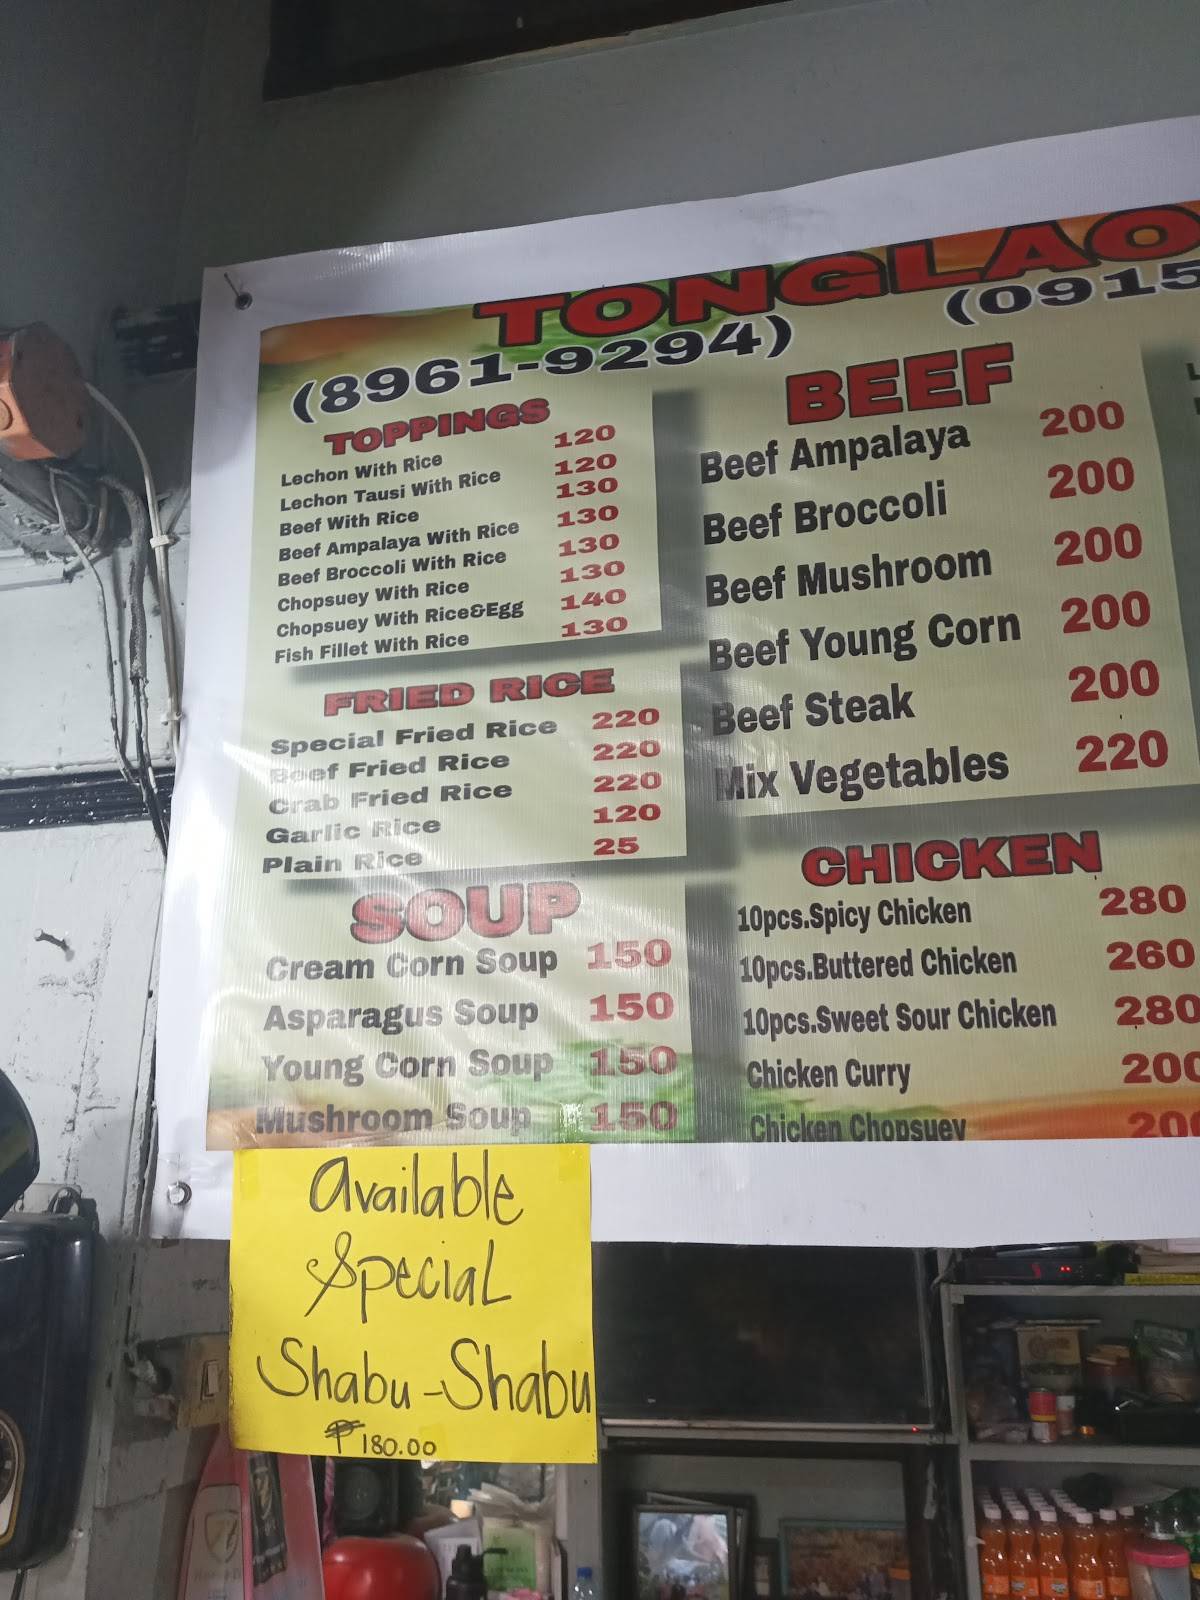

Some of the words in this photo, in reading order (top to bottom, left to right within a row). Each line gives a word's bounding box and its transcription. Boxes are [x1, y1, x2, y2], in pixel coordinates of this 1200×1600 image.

[474, 204, 1200, 346] TONGLAO
[946, 259, 1200, 327] (0915
[292, 314, 793, 422] (8961-9294)
[786, 342, 1014, 426] BEEF
[324, 398, 550, 456] TOPPINGS
[700, 441, 778, 484] Beef
[790, 424, 970, 471] Ampalaya
[1040, 400, 1125, 437] 200
[280, 492, 348, 511] Lechon
[354, 485, 405, 504] Tausi
[411, 477, 452, 497] With
[459, 470, 501, 488] Rice
[555, 454, 617, 476] 120
[281, 468, 349, 487] Lechon
[355, 461, 397, 480] With
[403, 454, 443, 473] Rice
[554, 425, 615, 448] 120
[280, 518, 322, 537] Beef
[328, 513, 370, 531] With
[377, 509, 419, 525] Rice
[556, 477, 618, 499] 130
[703, 503, 782, 545] Beef
[795, 479, 947, 534] Broccoli
[1047, 457, 1135, 499] 200
[279, 543, 321, 562] Beef
[327, 534, 421, 558] Ampalaya
[427, 528, 470, 547] With
[477, 520, 519, 540] Rice
[557, 505, 619, 528] 130
[277, 590, 369, 613] Chopsuey
[375, 586, 419, 604] With
[426, 580, 469, 598] Rice
[560, 560, 625, 583] 130
[278, 568, 320, 587] Beef
[327, 561, 406, 581] Broccoli
[412, 556, 456, 574] With
[463, 550, 507, 568] Rice
[558, 534, 620, 557] 130
[706, 566, 785, 607] Beef
[797, 547, 992, 597] Mushroom
[1053, 523, 1143, 567] 200
[276, 616, 369, 638] Chopsuey
[375, 610, 419, 629] With
[425, 600, 524, 623] Rice&Egg
[560, 588, 627, 611] 140
[708, 629, 789, 672] Beef
[801, 619, 917, 661] Young
[929, 612, 1021, 648] Corn
[1061, 591, 1151, 634] 200
[275, 646, 314, 664] Fish
[320, 641, 369, 660] Fillet
[375, 637, 418, 655] With
[425, 631, 469, 650] Rice
[561, 617, 628, 638] 130
[323, 682, 475, 717] FRIED
[489, 668, 615, 703] RICE
[712, 694, 793, 736] Beef
[805, 682, 915, 727] Steak
[1068, 660, 1160, 703] 200
[271, 731, 384, 757] Special
[396, 724, 474, 746] Fried
[486, 718, 558, 738] Rice
[592, 708, 660, 730] 220
[270, 764, 338, 785] Beef
[349, 757, 426, 778] Fried
[438, 753, 510, 773] Rice
[592, 740, 661, 761] 220
[714, 764, 778, 801] Mix
[790, 745, 1009, 802] Vegetables
[1075, 730, 1168, 773] 220
[269, 794, 339, 815] Crab
[351, 788, 428, 809] Fried
[441, 783, 512, 802] Rice
[593, 771, 662, 793] 220
[266, 823, 360, 844] Garlic
[372, 818, 441, 838] Rice
[593, 804, 661, 824] 120
[262, 854, 342, 874] Plain
[355, 851, 423, 870] Rice
[593, 837, 640, 856] 25
[801, 830, 1102, 886] CHICKEN
[350, 881, 582, 944] SOUP
[738, 903, 871, 936] 10pcs.Spicy
[878, 896, 971, 926] Chicken
[1099, 884, 1187, 916] 280
[266, 954, 374, 981] Cream
[386, 953, 464, 978] Corn
[476, 946, 557, 978] Soup
[587, 939, 672, 970] 150
[740, 948, 914, 988] 10pcs.Buttered
[921, 946, 1017, 977] Chicken
[1106, 938, 1195, 971] 260
[263, 1001, 442, 1036] Asparagus
[454, 998, 538, 1030] Soup
[590, 992, 674, 1022] 150
[743, 1003, 890, 1041] 10pcs.Sweet
[896, 1003, 950, 1032] Sour
[958, 998, 1057, 1030] Chicken
[1114, 994, 1200, 1027] 280
[262, 1054, 364, 1087] Young
[375, 1049, 456, 1079] Corn
[468, 1048, 554, 1081] Soup
[590, 1046, 678, 1076] 150
[746, 1059, 838, 1090] Chicken
[845, 1058, 911, 1094] Curry
[256, 1103, 432, 1135] Mushroom
[446, 1102, 531, 1134] Soup
[591, 1101, 678, 1131] 150
[749, 1114, 841, 1142] Chicken
